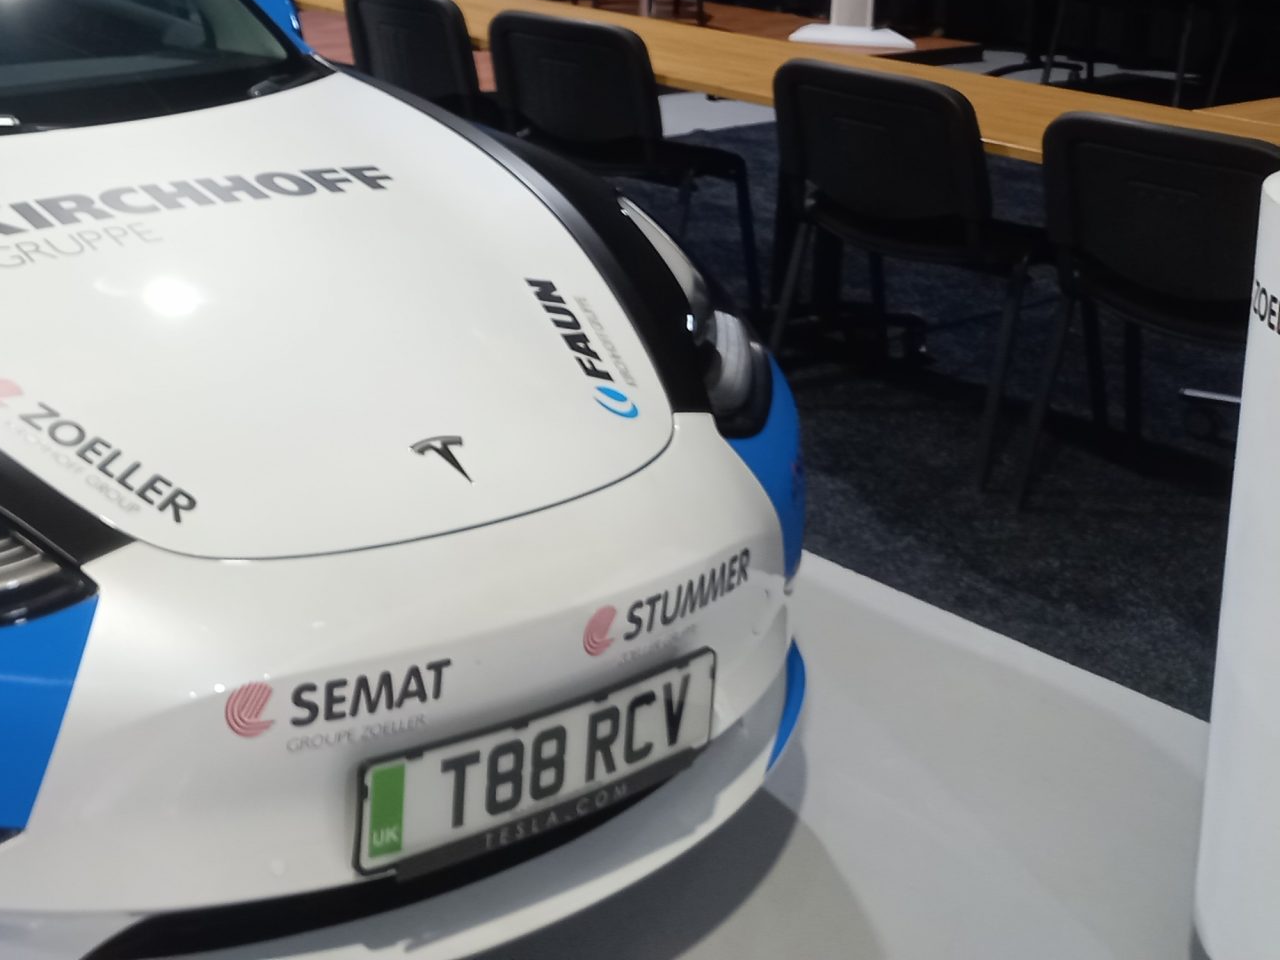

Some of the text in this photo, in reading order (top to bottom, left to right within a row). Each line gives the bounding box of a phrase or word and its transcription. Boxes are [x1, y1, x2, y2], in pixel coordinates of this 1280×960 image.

[523, 276, 615, 383] FAUN
[18, 400, 198, 524] ZOELLER
[622, 546, 751, 641] STUMMER
[289, 657, 452, 727] SEMAT
[440, 673, 691, 829] T88 RCV
[372, 826, 400, 846] UK
